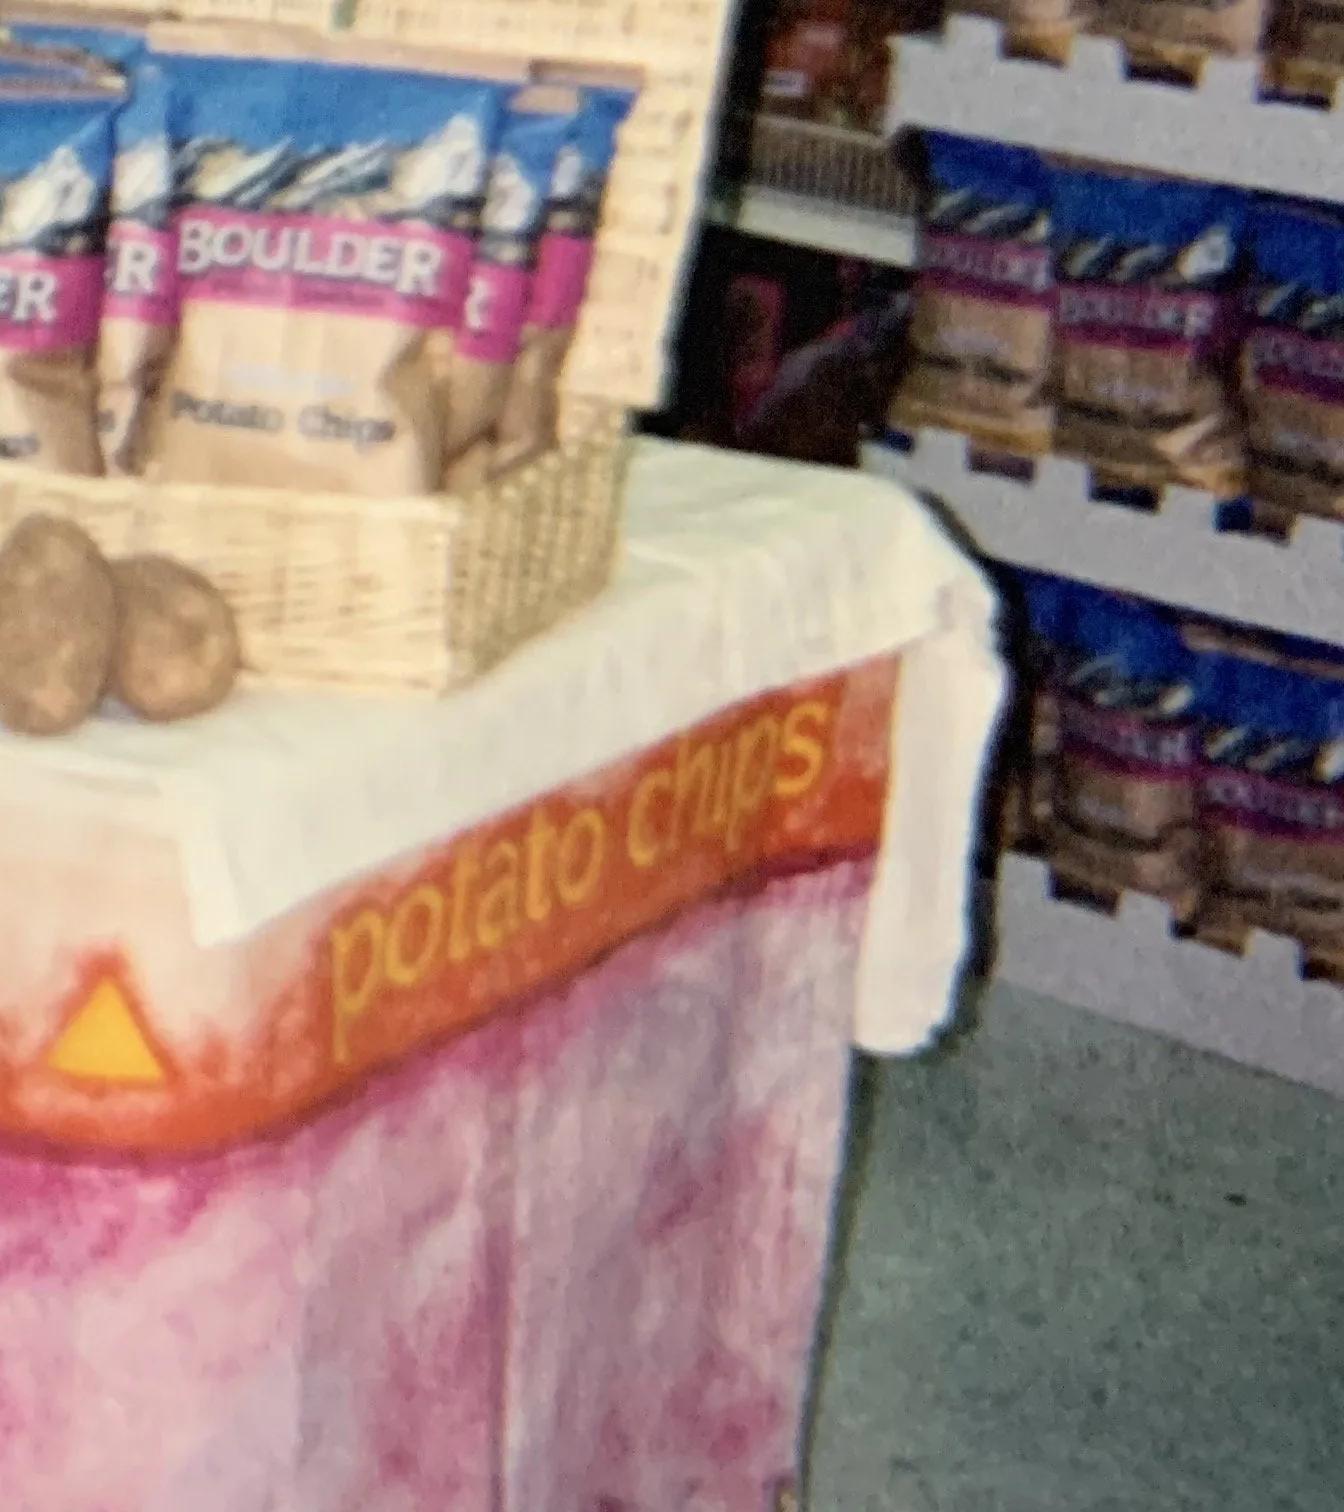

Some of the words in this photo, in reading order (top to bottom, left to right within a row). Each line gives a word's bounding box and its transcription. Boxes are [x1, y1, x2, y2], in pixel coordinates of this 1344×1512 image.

[177, 217, 446, 298] BOULDER
[330, 806, 605, 1065] potato
[627, 700, 830, 867] chips
